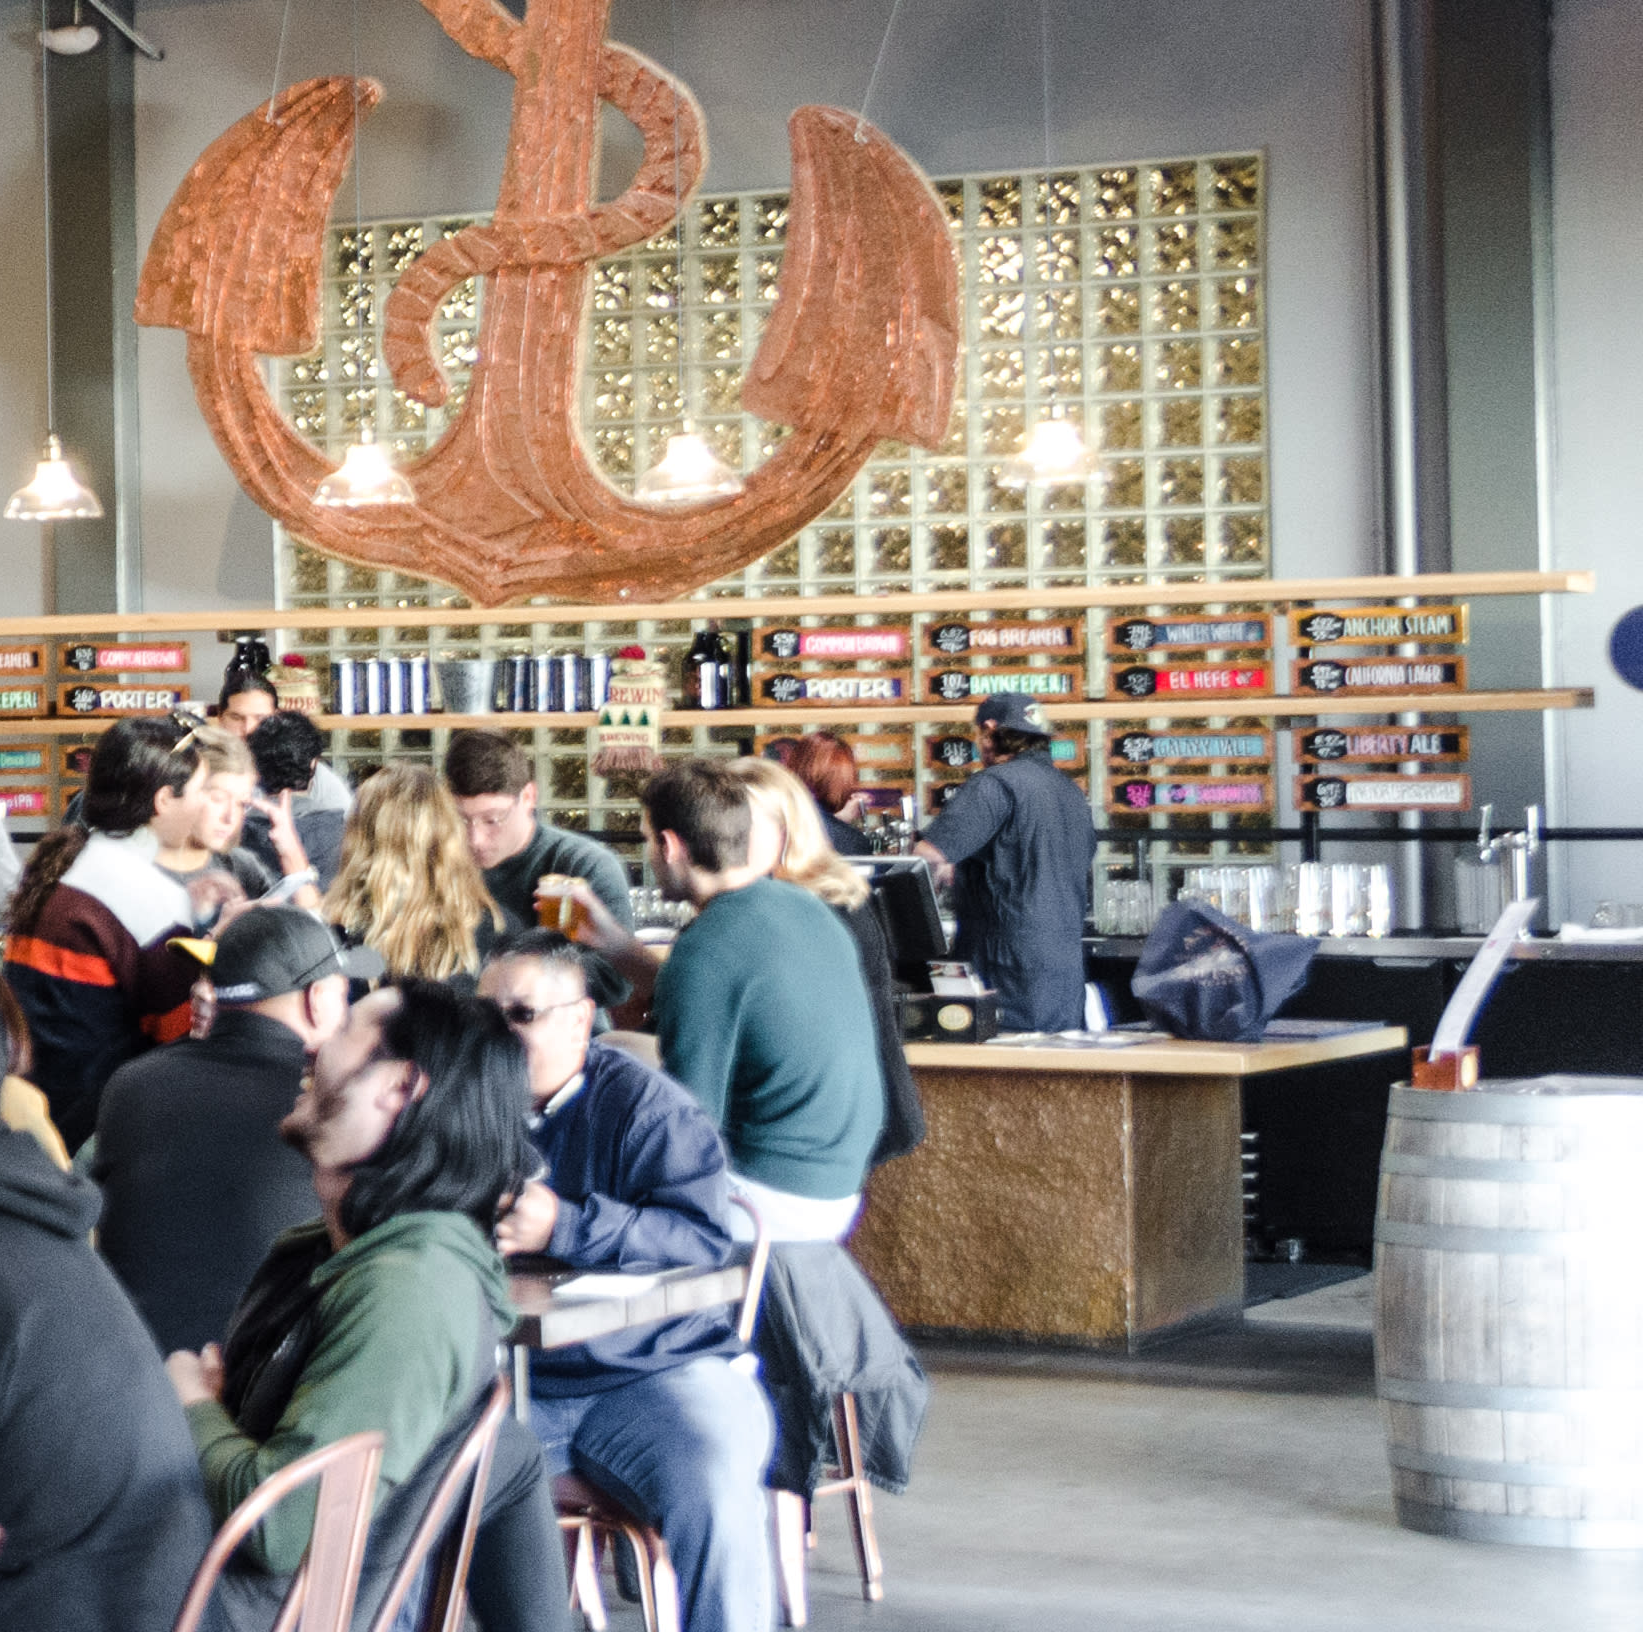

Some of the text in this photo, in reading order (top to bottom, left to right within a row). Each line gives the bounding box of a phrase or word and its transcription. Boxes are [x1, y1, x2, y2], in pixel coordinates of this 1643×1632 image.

[1344, 615, 1449, 636] ANCHOR STEAM
[969, 627, 1065, 647] FOG BREAKER
[1169, 670, 1230, 688] EL HEFE
[1345, 666, 1405, 685] CALIFORNIA
[1409, 664, 1441, 684] LAGER
[805, 679, 893, 698] PORTER
[100, 690, 172, 709] PORTER
[1155, 738, 1210, 756] GALAXY
[1347, 734, 1440, 754] LIBERTY ALE
